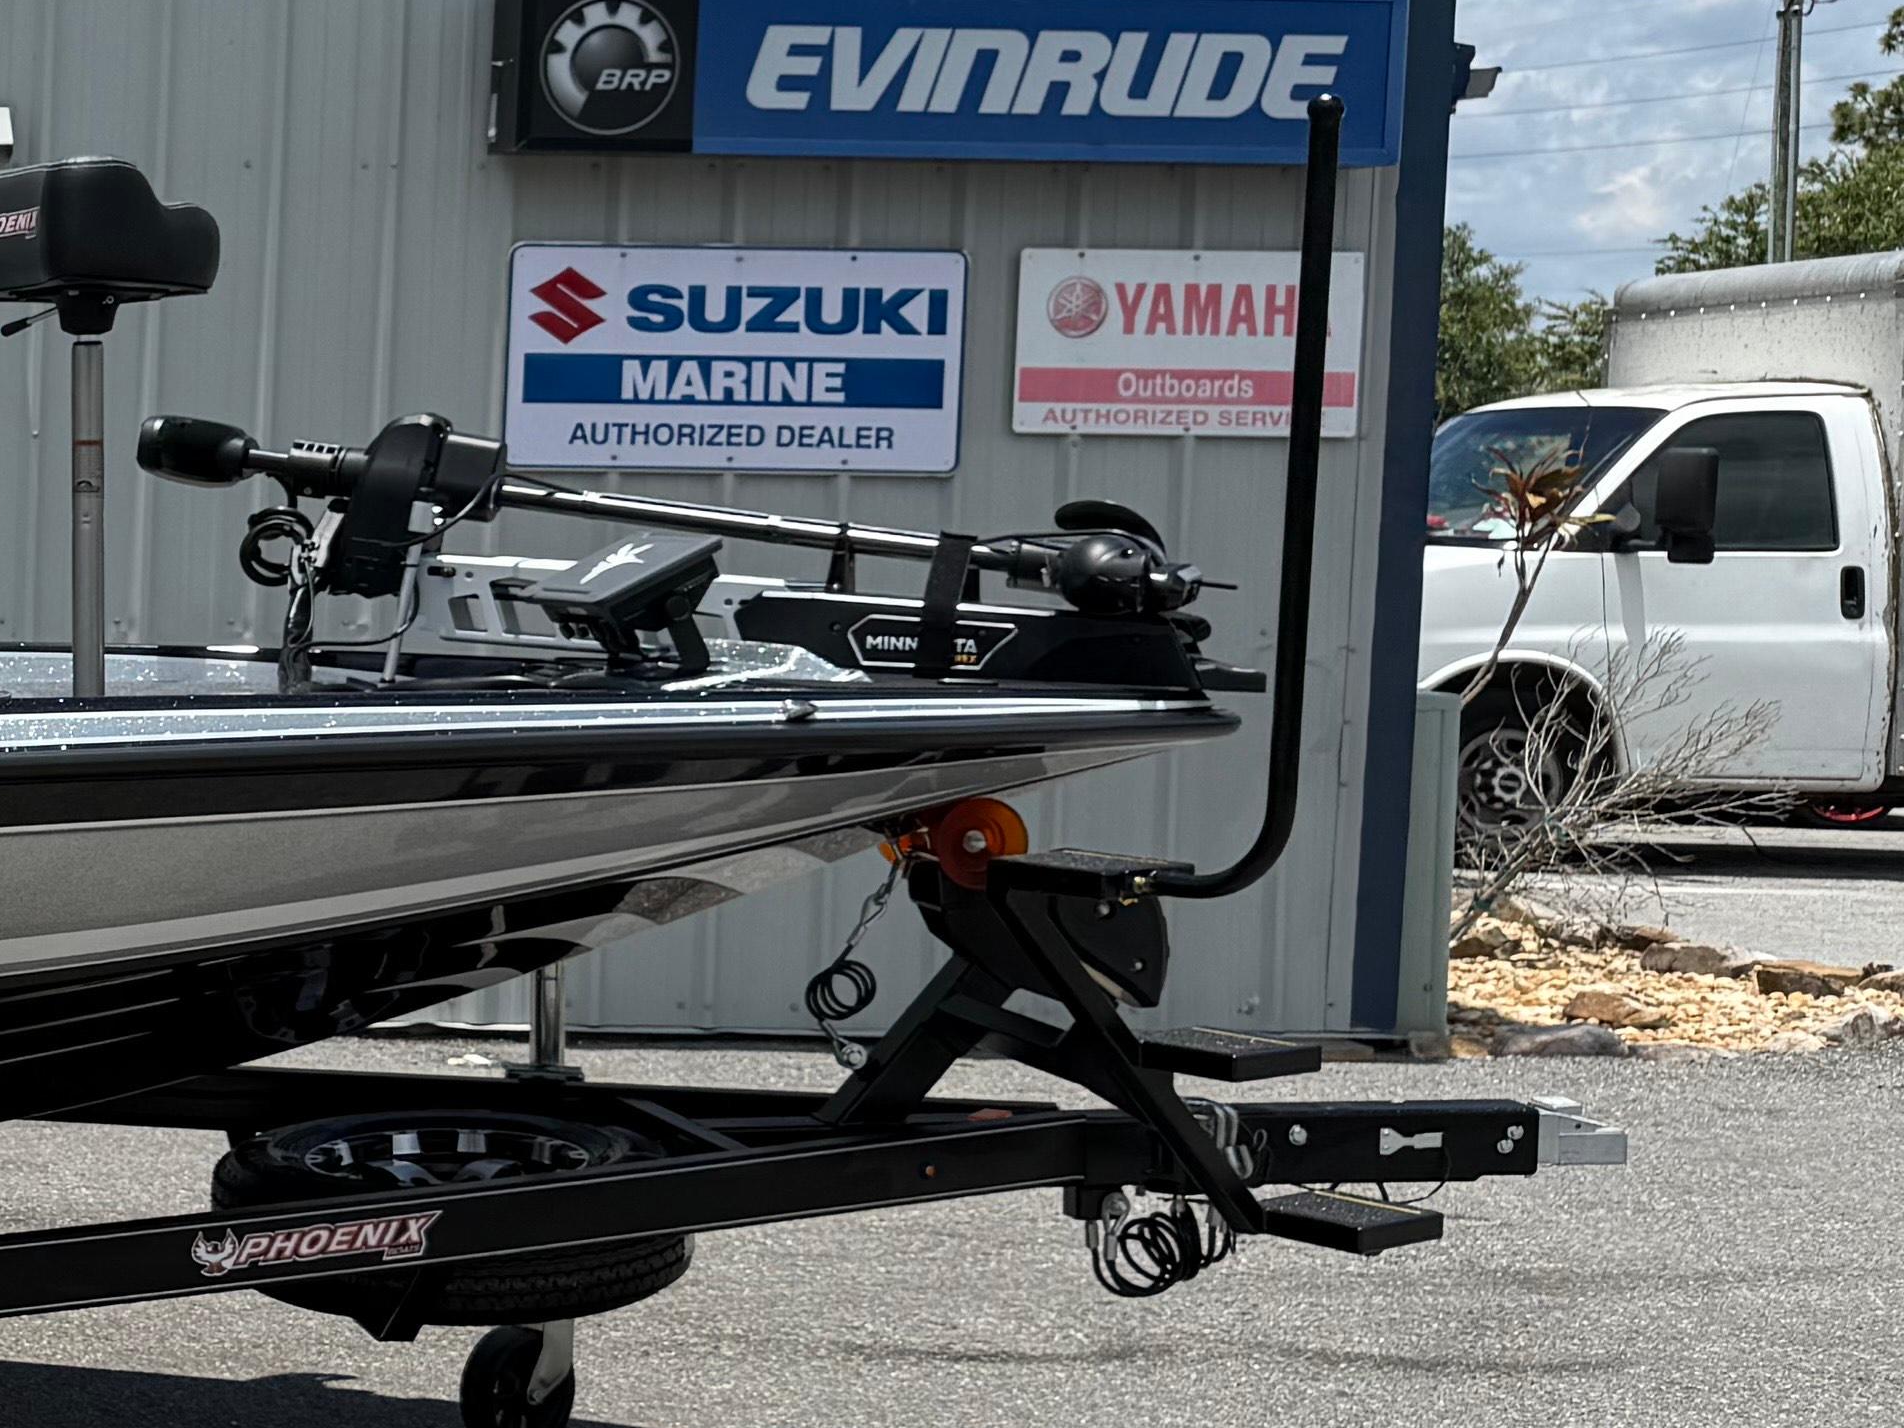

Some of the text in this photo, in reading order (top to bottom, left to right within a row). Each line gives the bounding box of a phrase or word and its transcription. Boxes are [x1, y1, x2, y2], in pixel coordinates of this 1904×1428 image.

[594, 23, 1349, 120] BRP EVINRUDE
[626, 283, 949, 336] SUZUKI
[1114, 281, 1332, 338] YAMAH
[620, 359, 847, 404] MARINE
[1117, 371, 1255, 399] Outboards
[568, 421, 895, 450] AUTHORIZED DEALER
[1042, 407, 1326, 429] AUTHORIZED SERVI
[865, 635, 919, 651] MINN
[235, 1217, 430, 1264] PHOENIX
